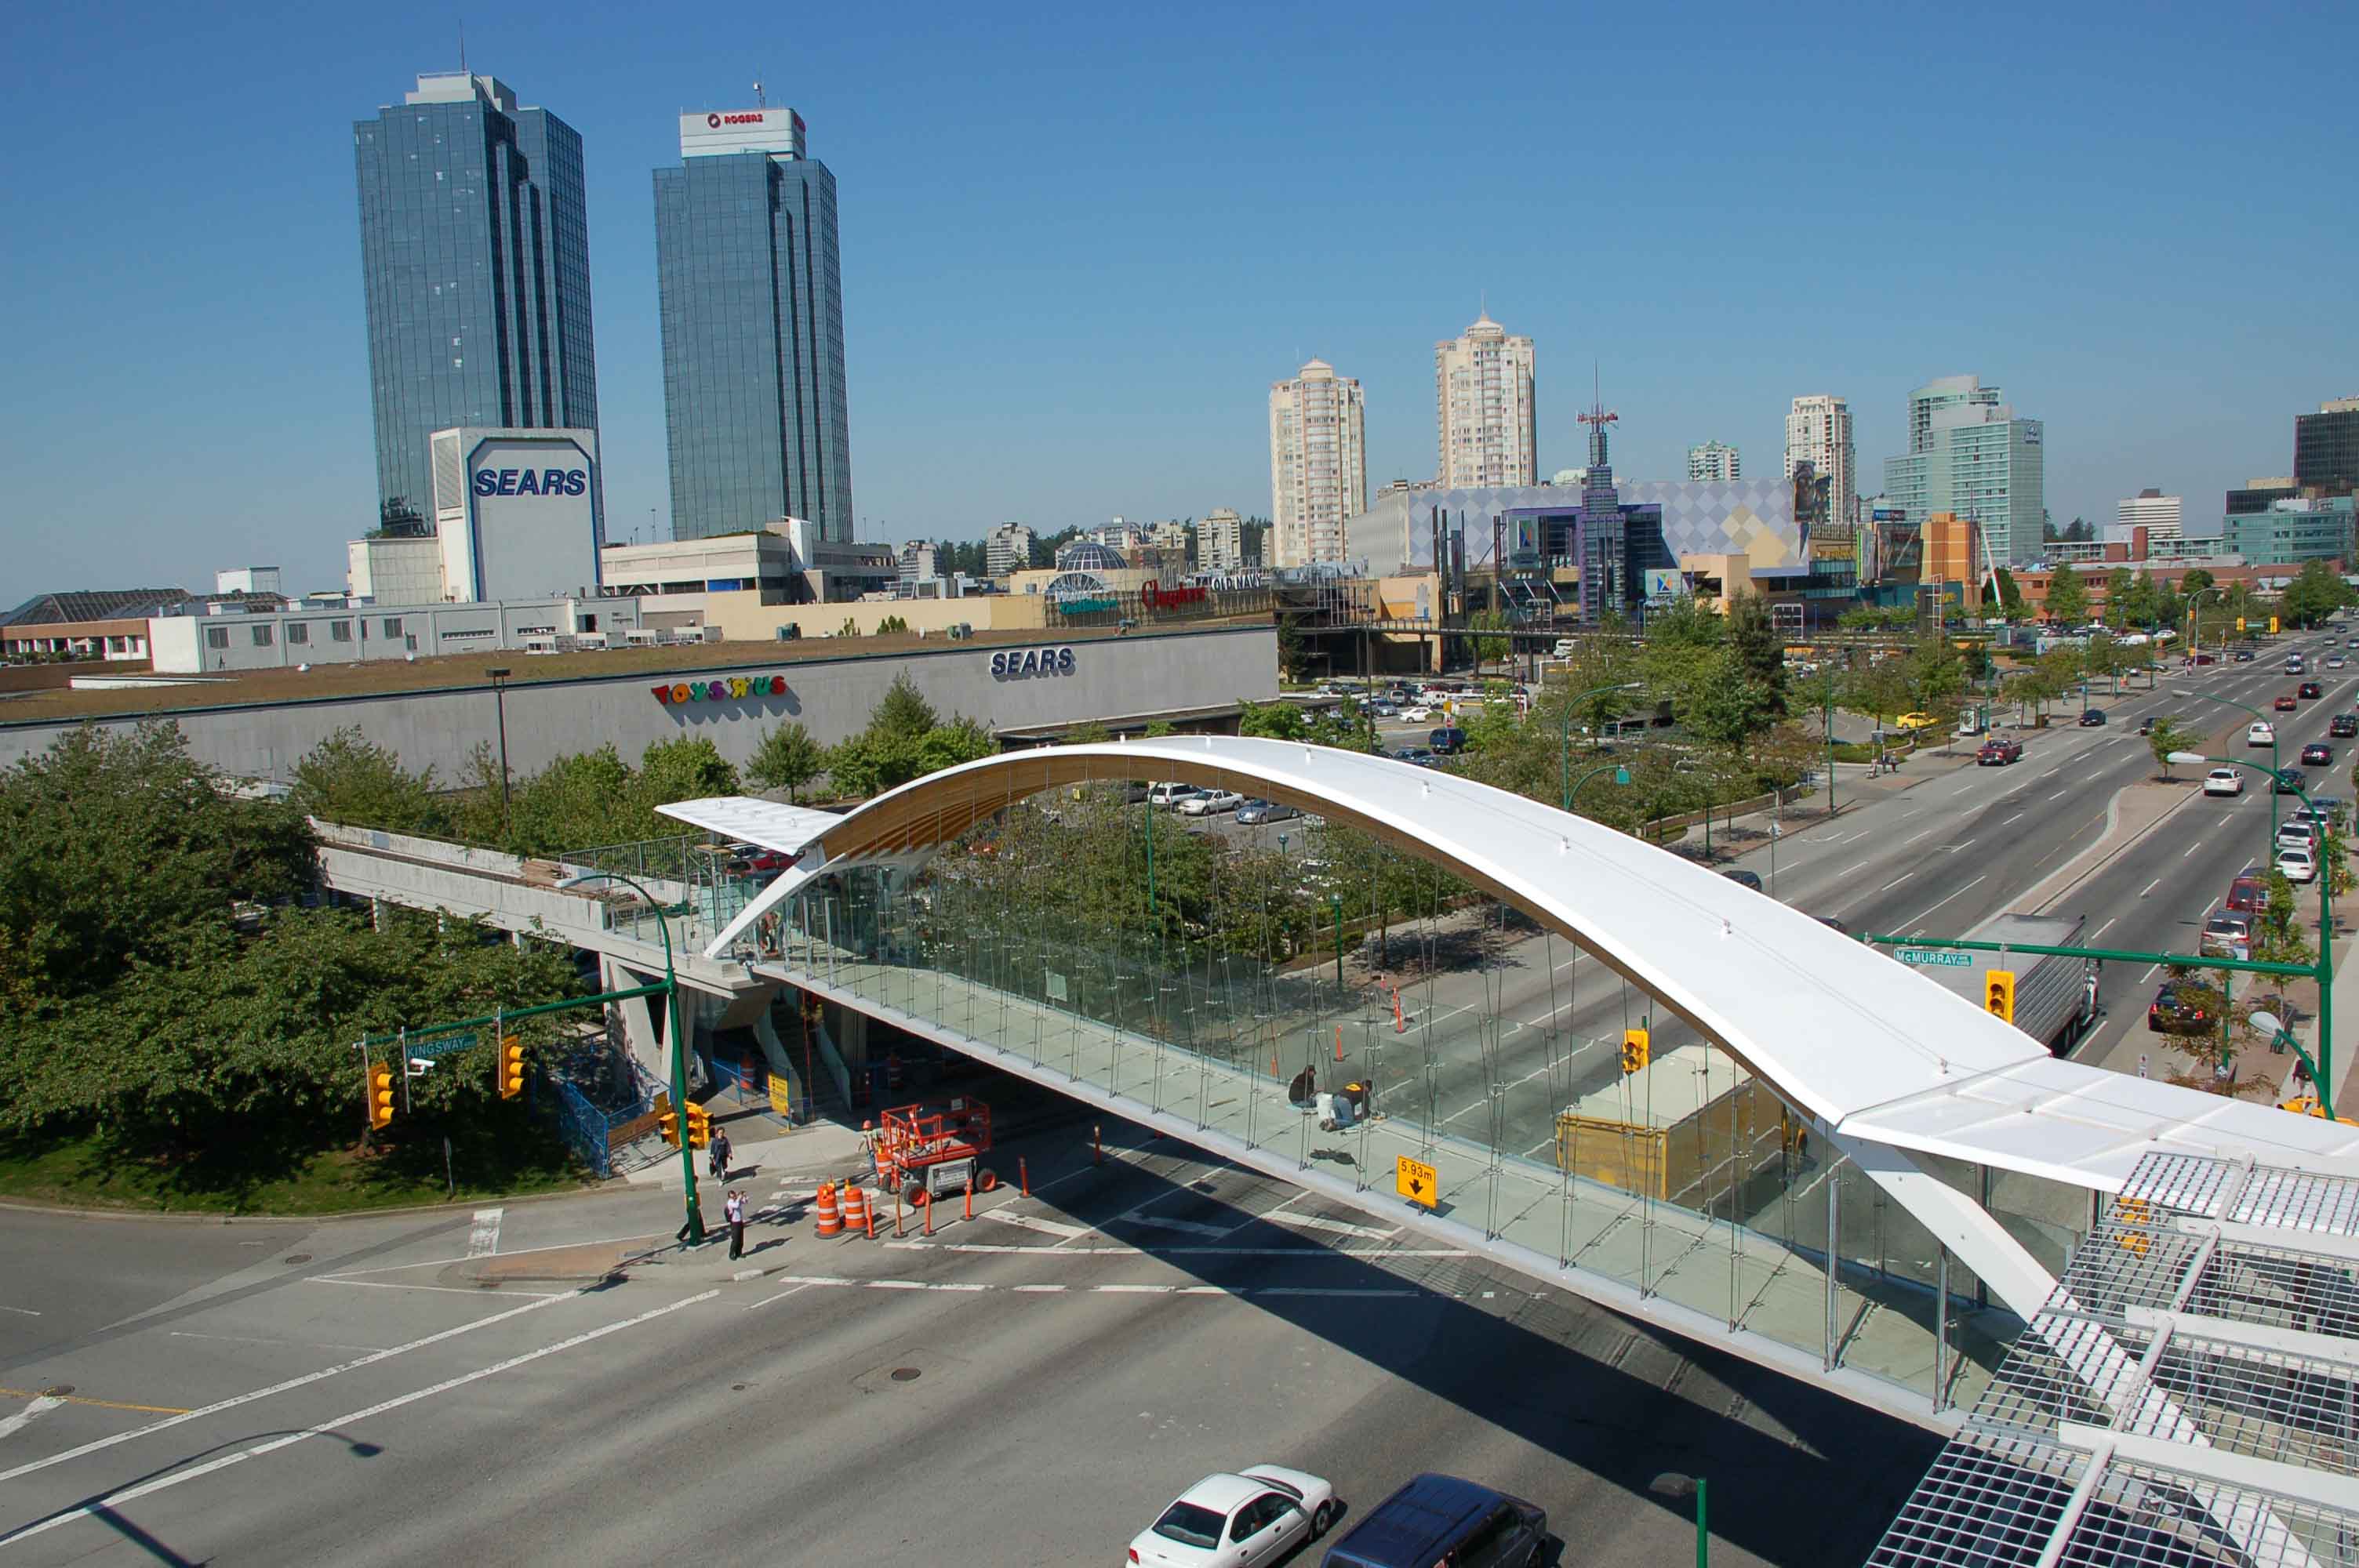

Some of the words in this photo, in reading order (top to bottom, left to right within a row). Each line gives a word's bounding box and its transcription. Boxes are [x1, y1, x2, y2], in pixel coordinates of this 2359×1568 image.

[725, 114, 763, 125] ROGERS
[474, 469, 586, 496] SEARS
[1212, 577, 1233, 590] OLD
[1236, 574, 1262, 590] NAVY
[991, 648, 1073, 674] SEARS
[652, 681, 725, 703] TOYS
[753, 676, 787, 695] US
[1896, 951, 1957, 965] McMURRAY
[407, 1038, 464, 1058] KINGSWAY
[1401, 1160, 1432, 1181] 5.93m
